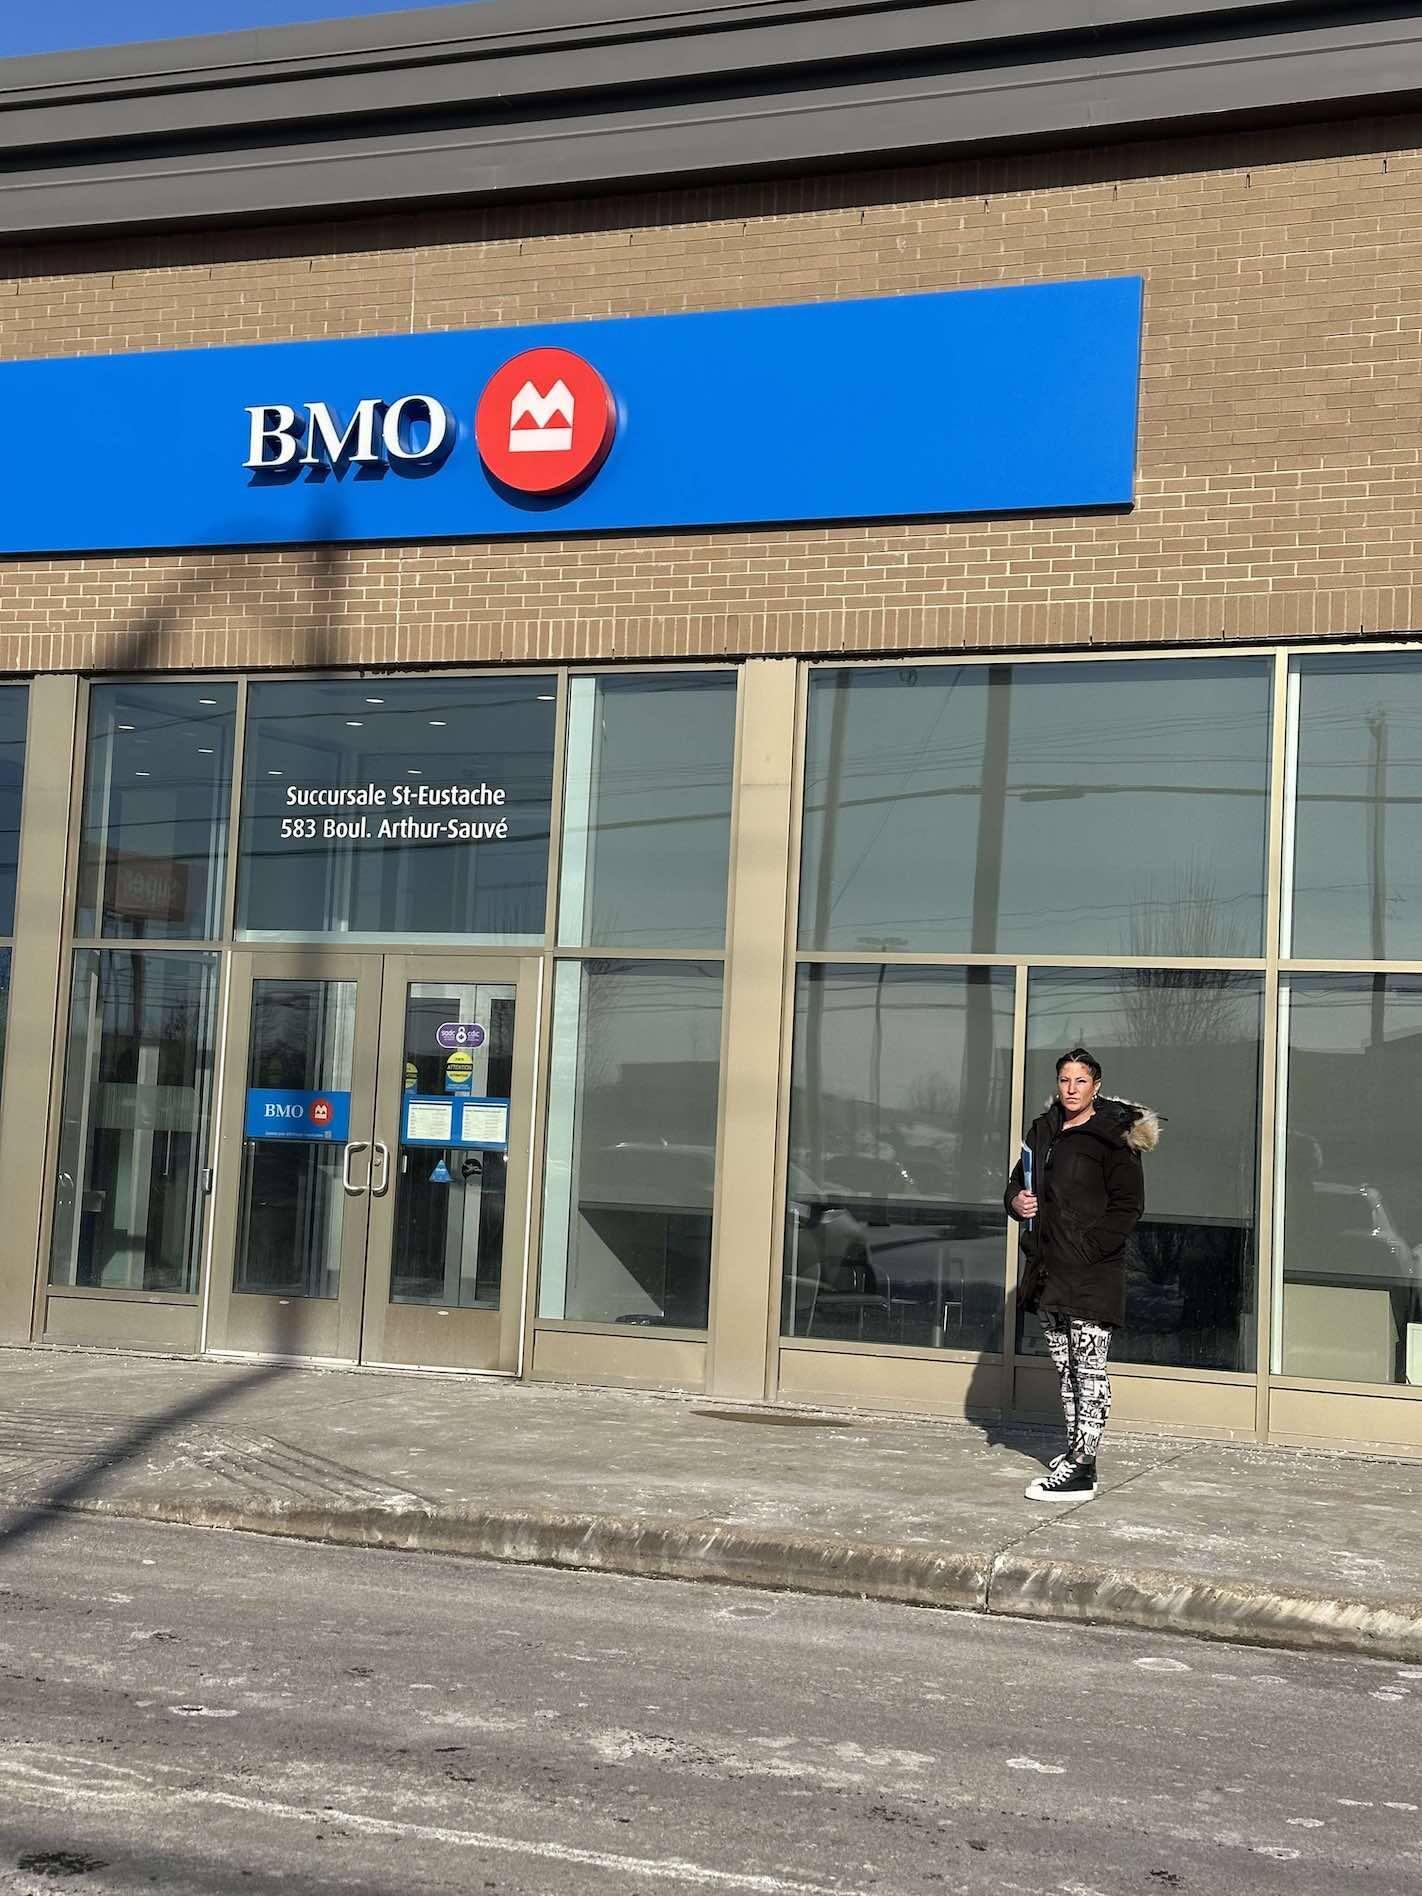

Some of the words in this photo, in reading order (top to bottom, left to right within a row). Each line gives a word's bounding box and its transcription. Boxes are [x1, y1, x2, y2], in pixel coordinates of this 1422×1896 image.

[242, 395, 447, 467] BMO
[286, 783, 386, 806] Succursale
[391, 783, 506, 806] St-Eustache
[280, 818, 317, 839] 583
[323, 816, 371, 839] Boul.
[377, 816, 509, 839] Arthur-Sauvé
[263, 1103, 304, 1118] BMO
